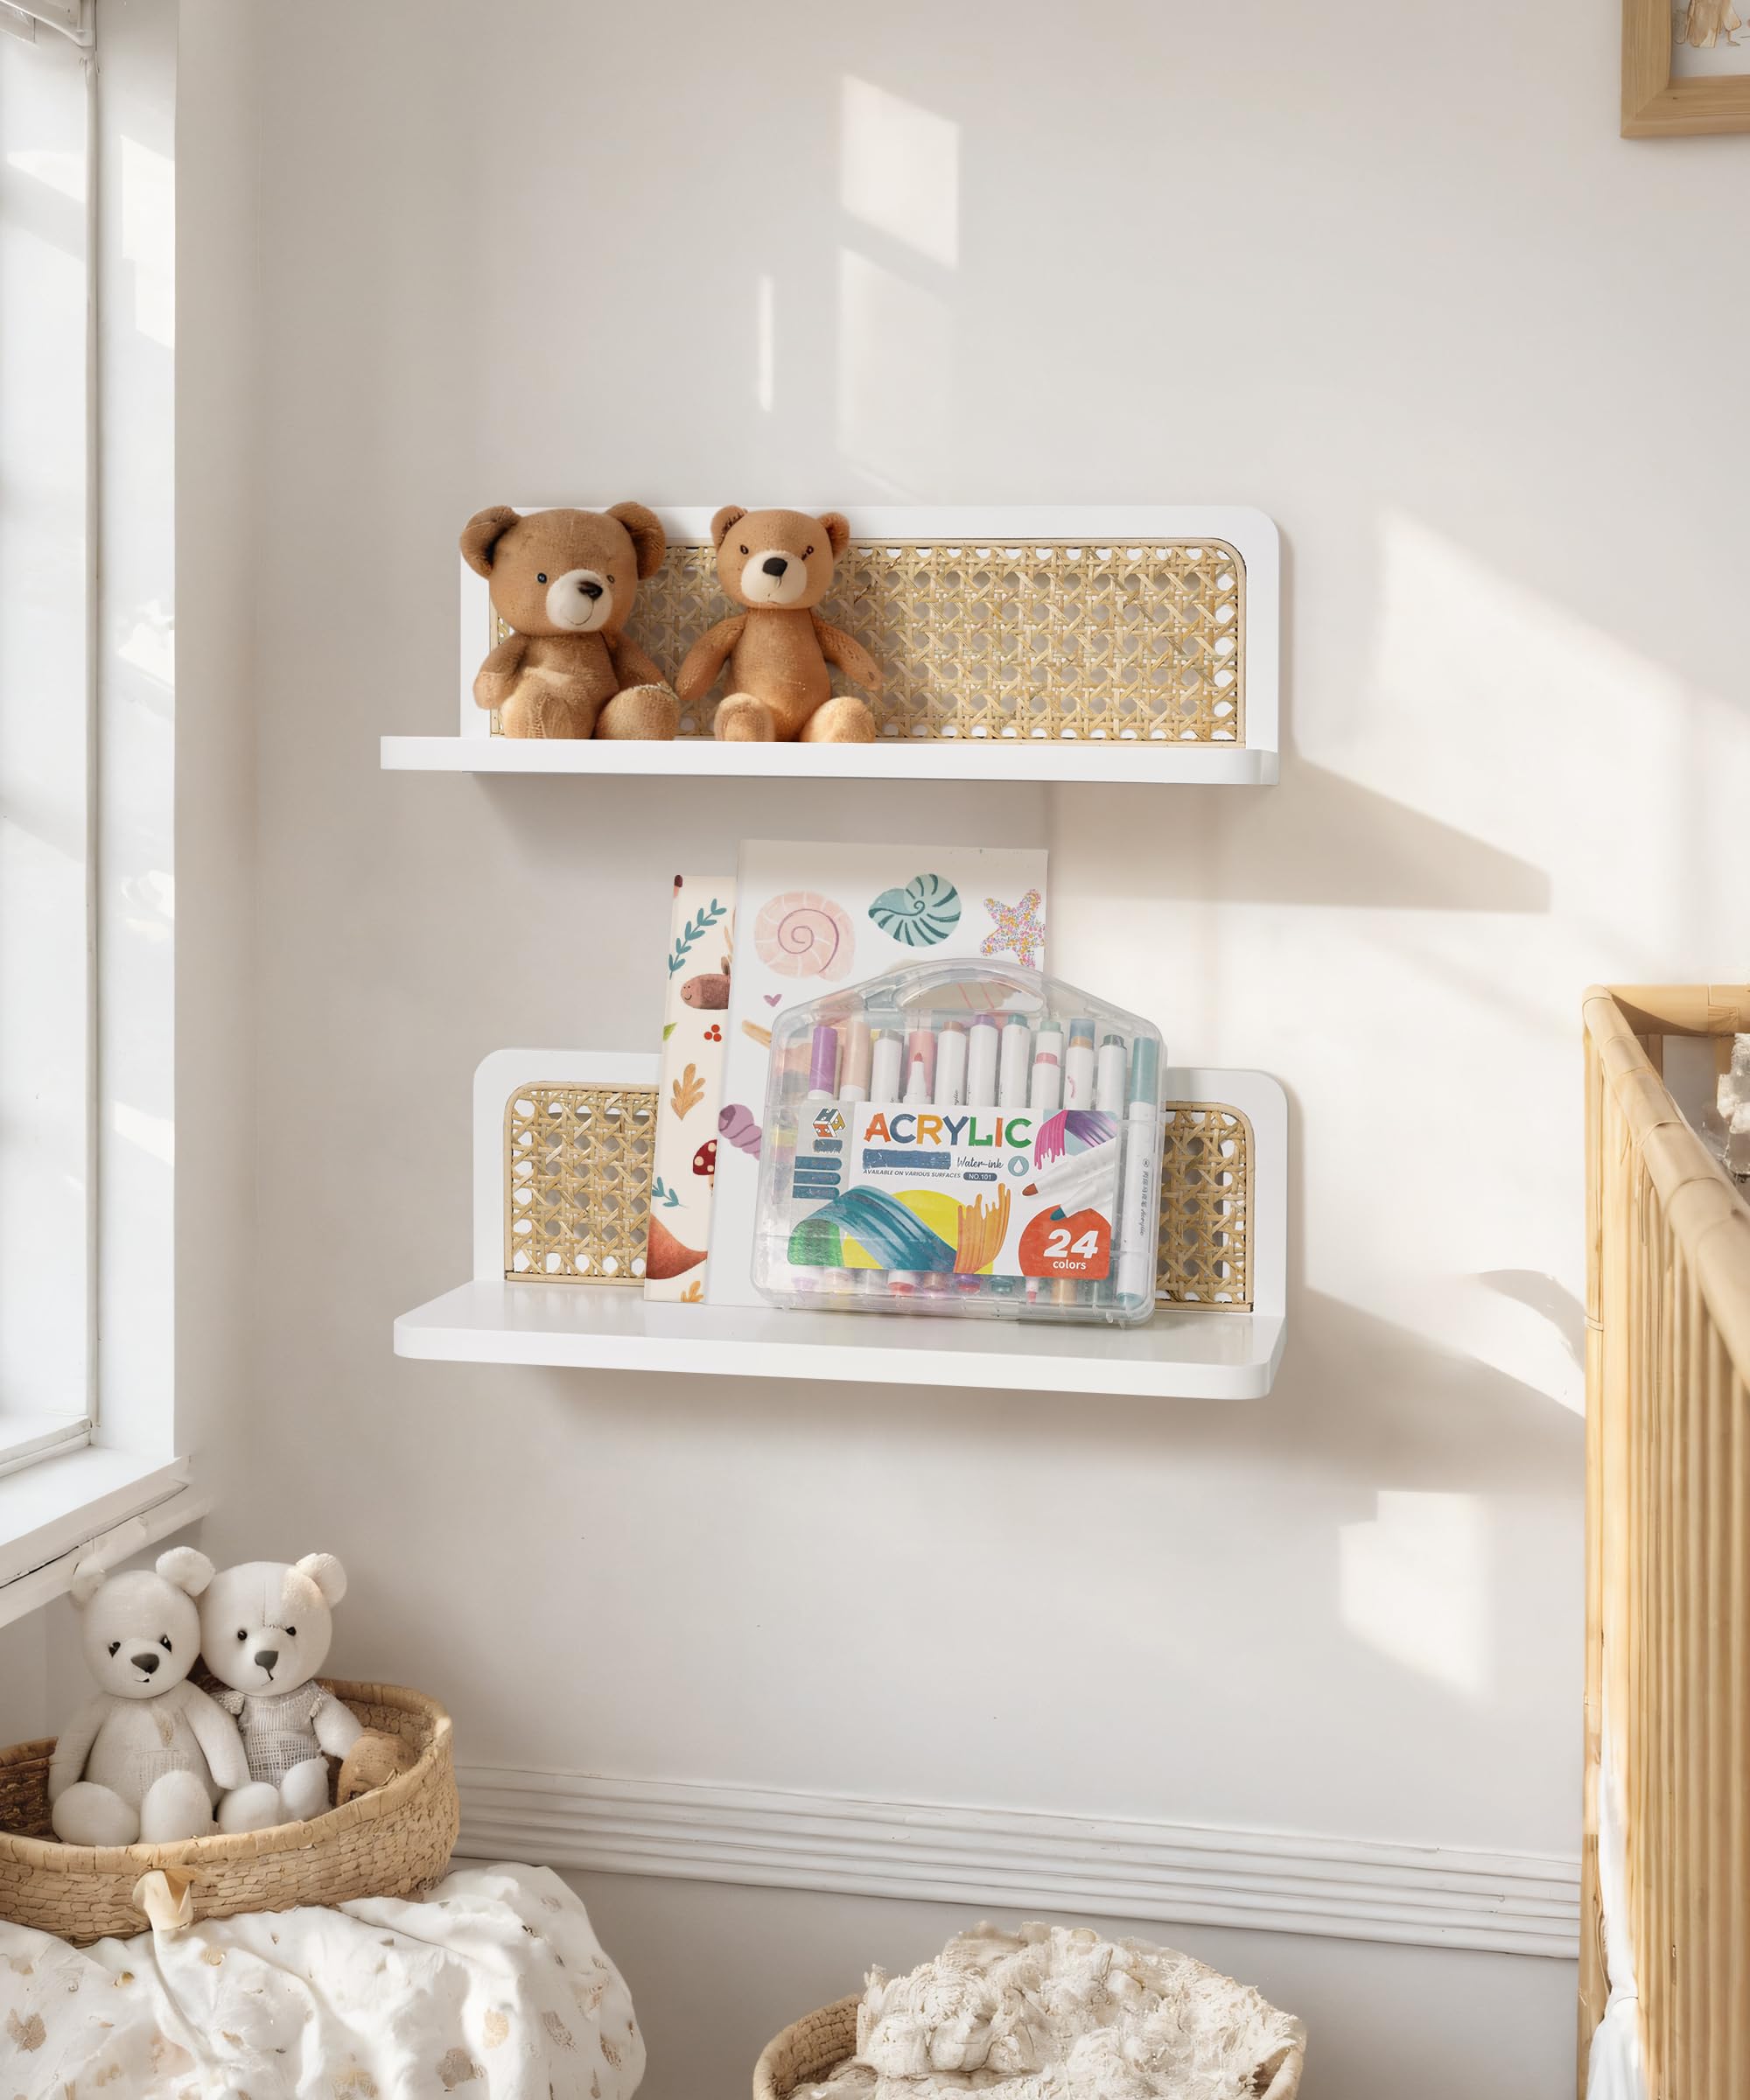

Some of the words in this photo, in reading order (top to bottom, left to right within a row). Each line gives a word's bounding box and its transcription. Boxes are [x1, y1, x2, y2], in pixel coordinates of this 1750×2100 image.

[863, 1112, 1032, 1148] ACRYLIC
[956, 1156, 1004, 1169] Water-ink
[1043, 1228, 1099, 1259] 24
[1053, 1259, 1087, 1270] colors
